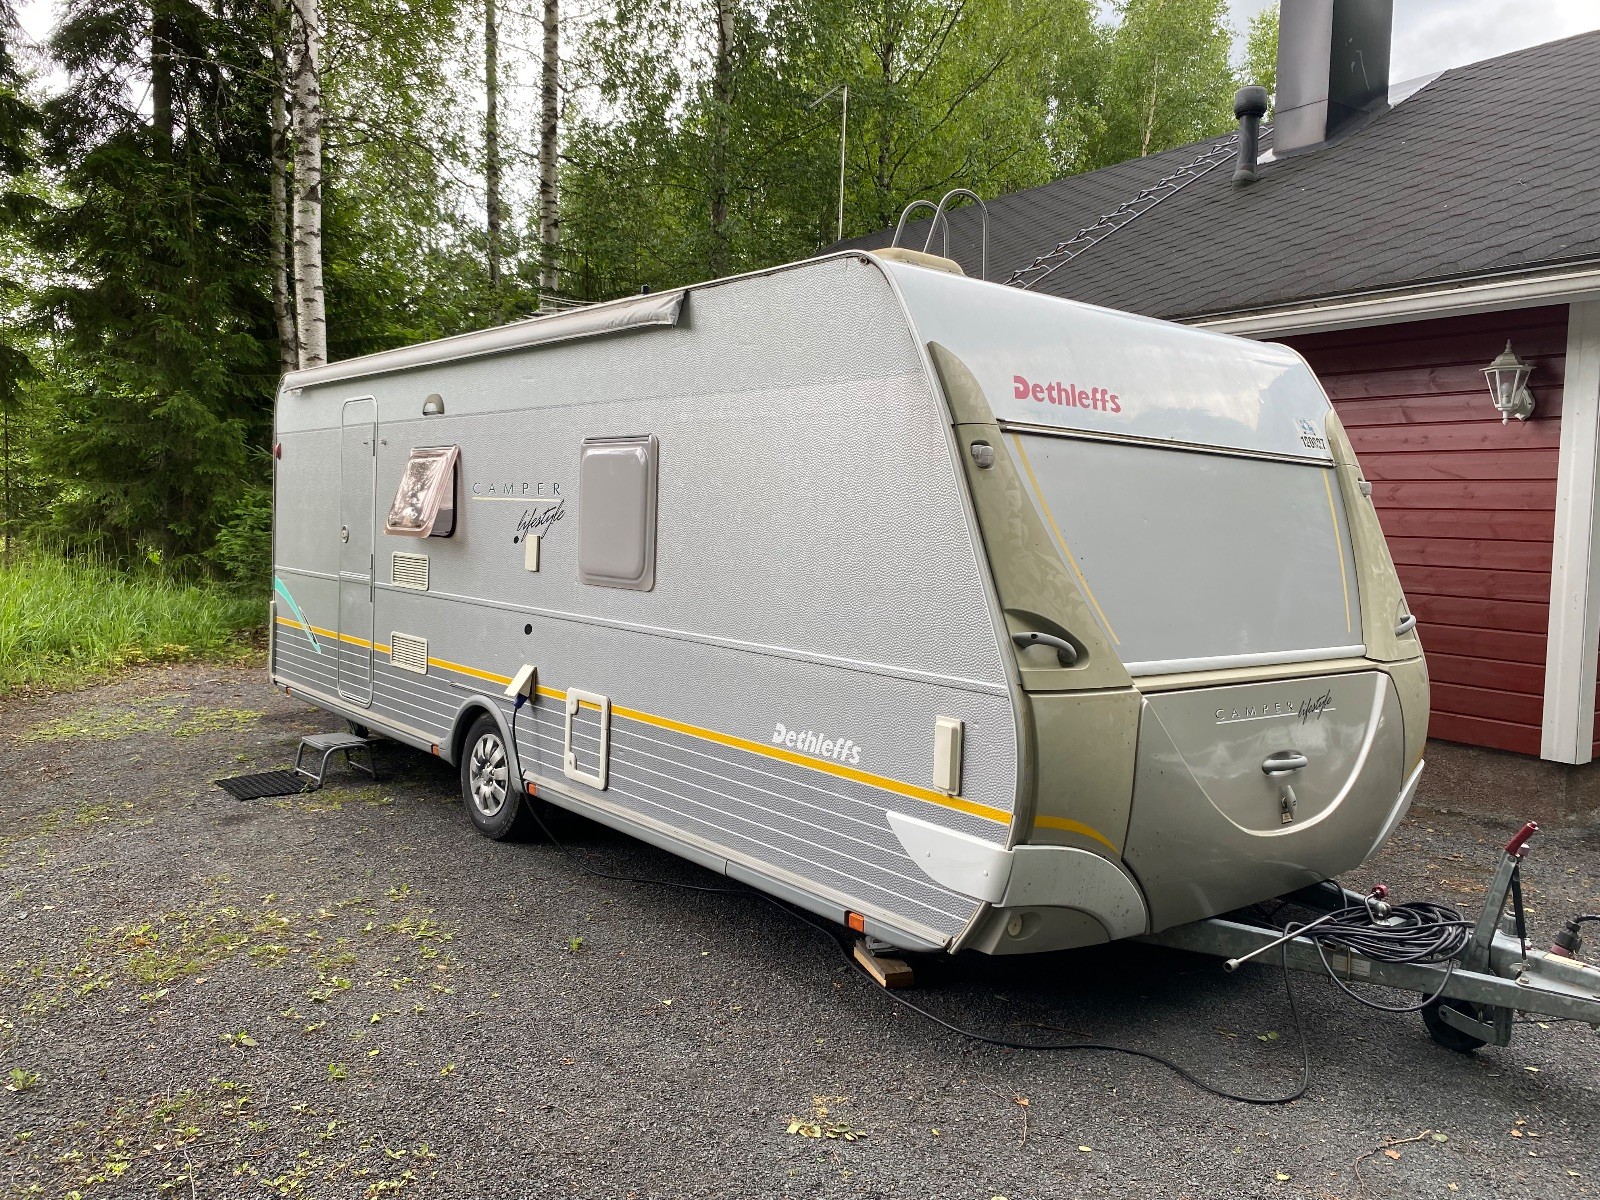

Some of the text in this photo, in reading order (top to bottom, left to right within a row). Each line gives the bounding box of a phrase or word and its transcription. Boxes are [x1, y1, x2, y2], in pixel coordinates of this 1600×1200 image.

[1013, 375, 1121, 413] Dethleffs
[472, 482, 561, 496] CAMPER
[516, 498, 565, 543] lifestyle
[1215, 689, 1332, 725] CAMPER lifestyle
[772, 722, 862, 765] Dethleffs
